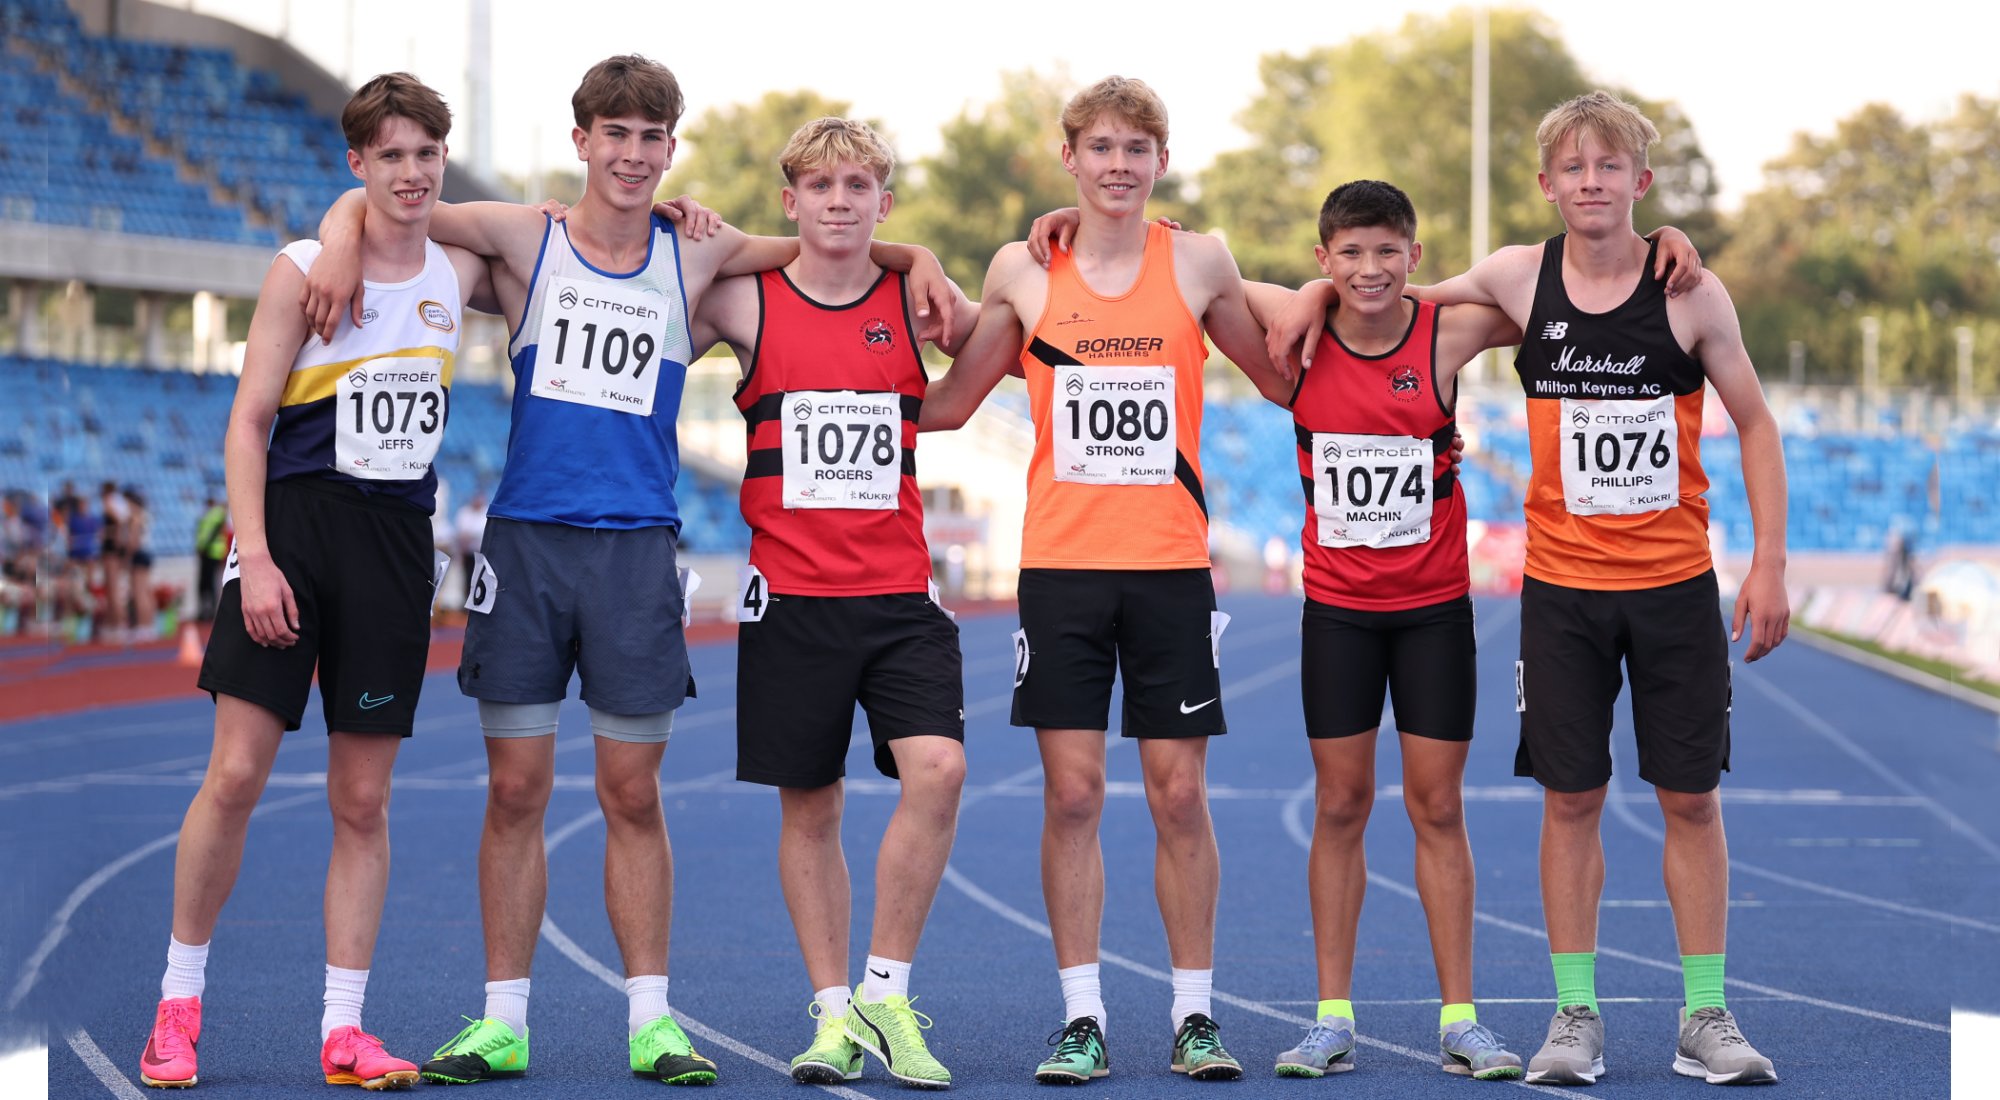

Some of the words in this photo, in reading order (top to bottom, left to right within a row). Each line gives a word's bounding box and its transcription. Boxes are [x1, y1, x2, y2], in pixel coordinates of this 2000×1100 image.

[583, 298, 658, 320] CITROËN
[554, 318, 655, 380] 1109
[1075, 337, 1164, 354] BORDER
[1089, 351, 1149, 359] HARRIERS
[1551, 345, 1646, 375] Marshall
[1089, 380, 1165, 391] CITROËN
[1536, 380, 1577, 393] Milton
[1582, 381, 1635, 397] Keynes
[1640, 383, 1661, 394] AC
[610, 391, 644, 406] KUKRI
[349, 391, 440, 434] 1073
[818, 404, 893, 415] CITROËN
[1065, 399, 1168, 441] 1080
[1595, 410, 1666, 424] CITROËN
[378, 439, 414, 450] JEFFS
[794, 423, 895, 466] 1078
[1085, 445, 1145, 457] STRONG
[1572, 428, 1671, 473] 1076
[1346, 447, 1422, 458] CITROËN
[815, 469, 873, 480] ROGERS
[1130, 467, 1166, 476] KUKRI
[1324, 465, 1426, 507] 1074
[1591, 475, 1653, 487] PHILLIPS
[858, 491, 891, 500] KUKRI
[1637, 493, 1671, 505] KUKRI
[1346, 511, 1401, 522] MACHIN
[1388, 528, 1421, 538] KUKRI
[473, 564, 487, 606] 6
[743, 574, 762, 617] 4
[1016, 637, 1026, 683] 2
